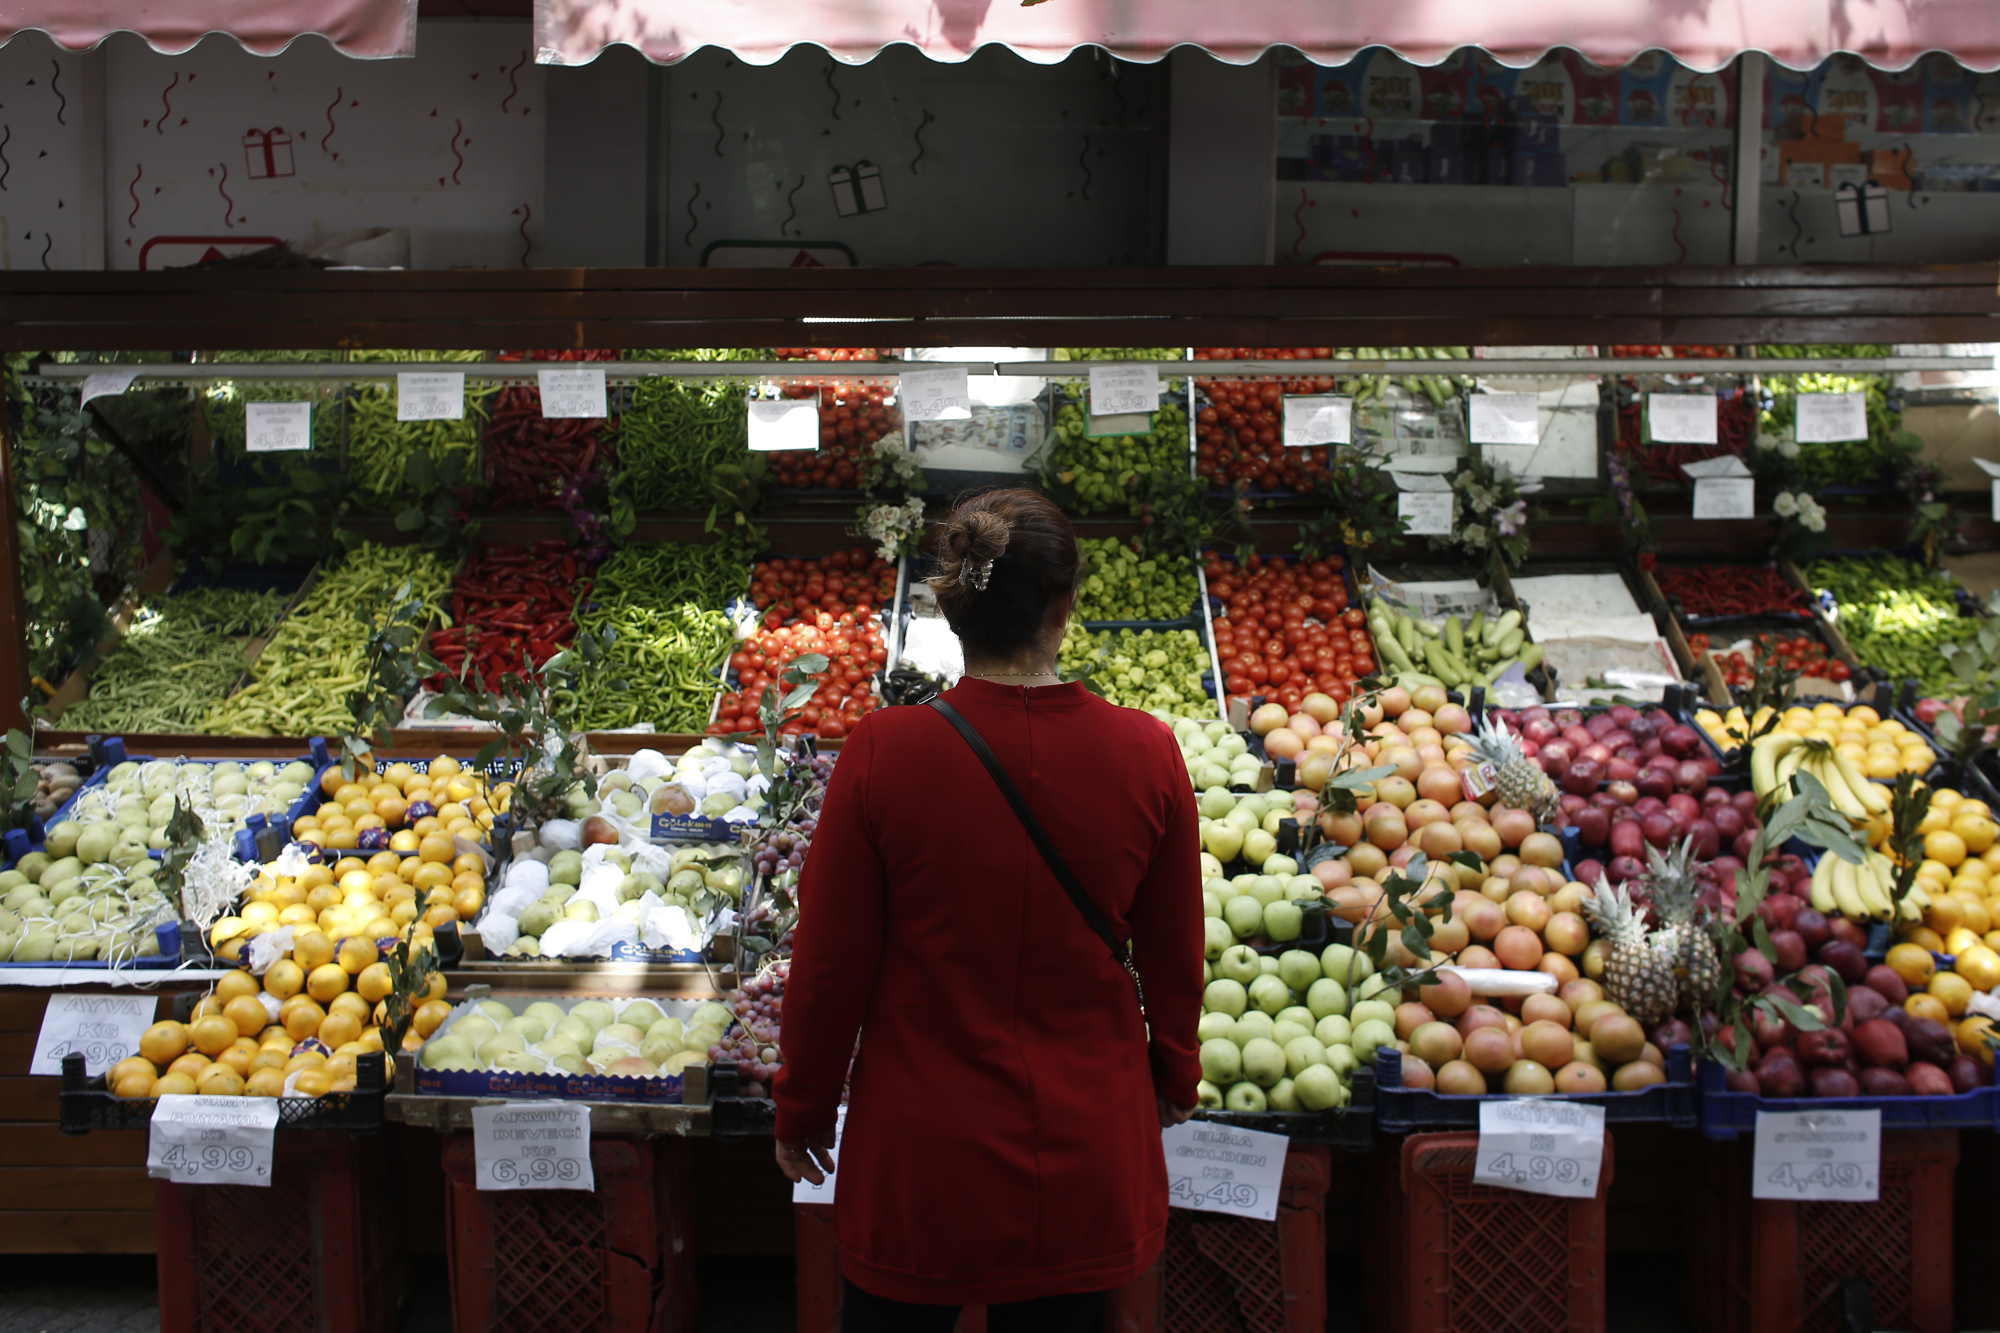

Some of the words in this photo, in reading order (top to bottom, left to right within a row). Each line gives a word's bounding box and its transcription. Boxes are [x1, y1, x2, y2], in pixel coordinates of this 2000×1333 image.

[1098, 395, 1148, 412] 4,99
[64, 996, 143, 1017] AYVA
[77, 1022, 120, 1040] KG
[48, 1041, 129, 1066] 499
[194, 1096, 249, 1108] SIKMA
[170, 1111, 262, 1126] PORTAKAL
[492, 1110, 580, 1124] ARMUT
[1496, 1103, 1590, 1127] GREYFURT
[200, 1129, 227, 1141] KG
[493, 1127, 581, 1140] DEVECİ
[1193, 1130, 1253, 1148] ELMA
[521, 1145, 556, 1158] KG
[1529, 1134, 1556, 1152] KG
[161, 1144, 253, 1175] 4,99
[1176, 1146, 1266, 1167] GOLDEN
[491, 1157, 580, 1187] 6,99
[1202, 1165, 1234, 1180] KG
[1488, 1152, 1580, 1184] 4,99
[1767, 1162, 1862, 1193] 4,49
[1169, 1176, 1258, 1208] 4,49
